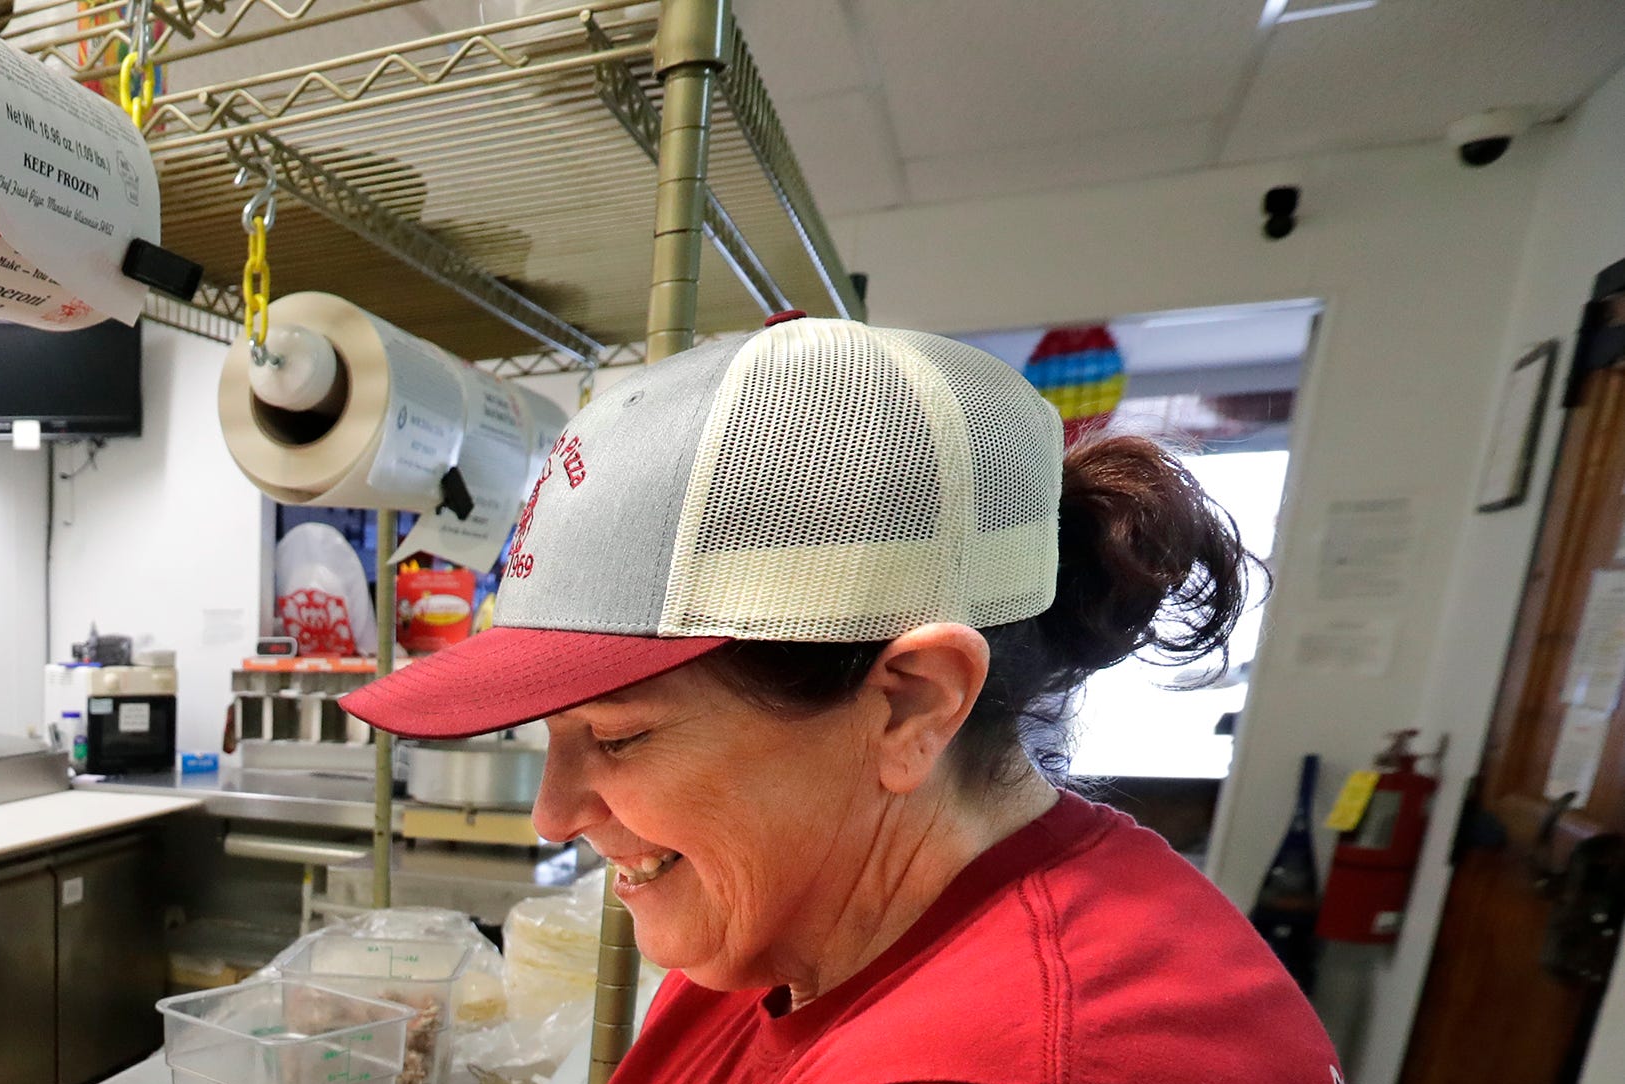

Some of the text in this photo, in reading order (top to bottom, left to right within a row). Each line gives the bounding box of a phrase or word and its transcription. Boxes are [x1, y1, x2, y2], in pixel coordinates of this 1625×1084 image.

[6, 103, 21, 126] Net
[23, 112, 38, 134] Wt.
[39, 122, 61, 146] 16.96
[63, 137, 74, 152] oz.
[23, 153, 54, 178] KEEP
[57, 169, 99, 200] FROZEN
[0, 256, 21, 272] Make
[559, 435, 586, 489] Pizza
[506, 552, 534, 579] 1969
